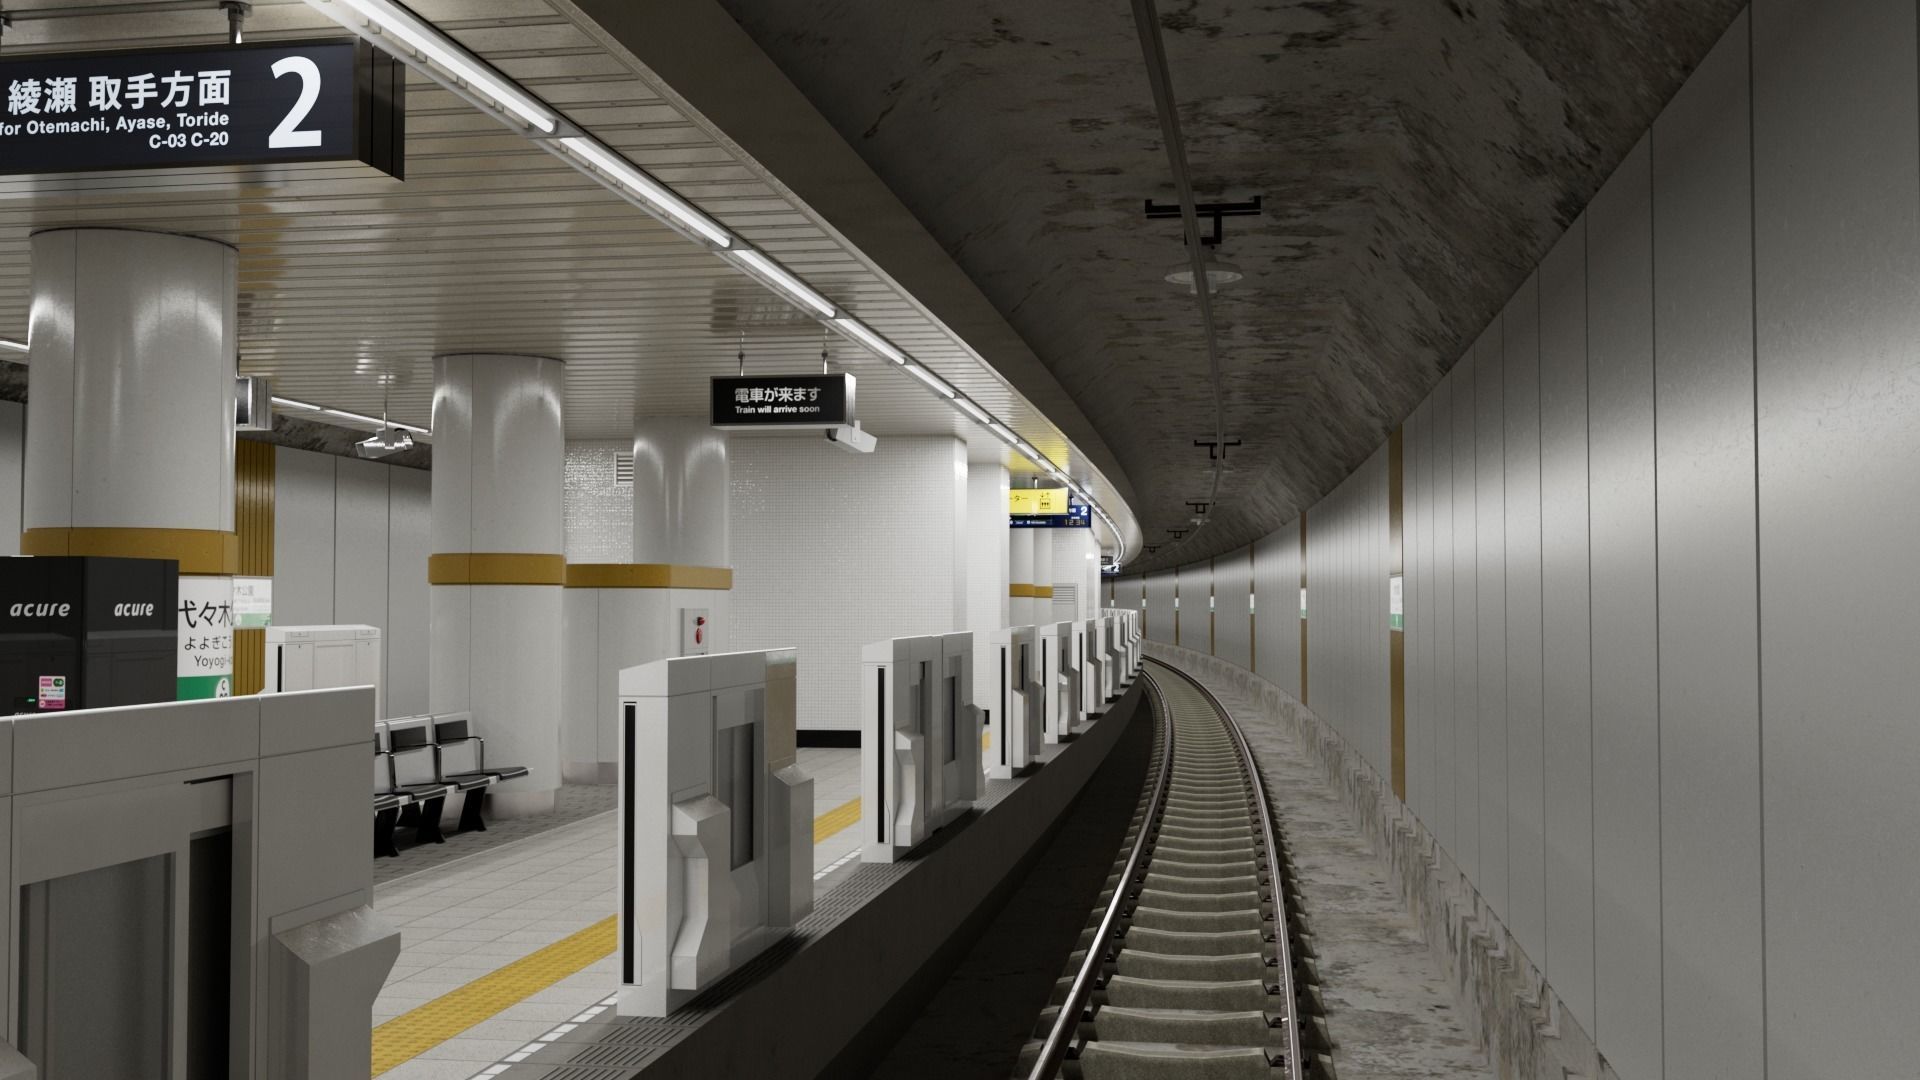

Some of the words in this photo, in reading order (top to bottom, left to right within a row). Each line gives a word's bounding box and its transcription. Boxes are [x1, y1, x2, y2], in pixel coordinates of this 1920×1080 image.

[7, 77, 78, 115] 綾瀬
[88, 70, 231, 112] 取手方面
[268, 56, 322, 148] 2
[0, 121, 21, 136] for
[26, 116, 110, 135] Otemachi,
[115, 115, 171, 133] Ayase,
[176, 111, 230, 128] Toride
[149, 134, 187, 149] C-03
[190, 131, 230, 147] C-20
[735, 386, 821, 403] 電車が来ます
[735, 405, 756, 414] Train
[757, 405, 772, 414] will
[773, 404, 798, 414] arrive
[799, 405, 820, 413] soon
[1080, 506, 1088, 516] 2
[10, 603, 71, 617] acure
[114, 603, 154, 617] acure
[178, 600, 233, 628] 代々木
[184, 636, 232, 651] よよぎこ
